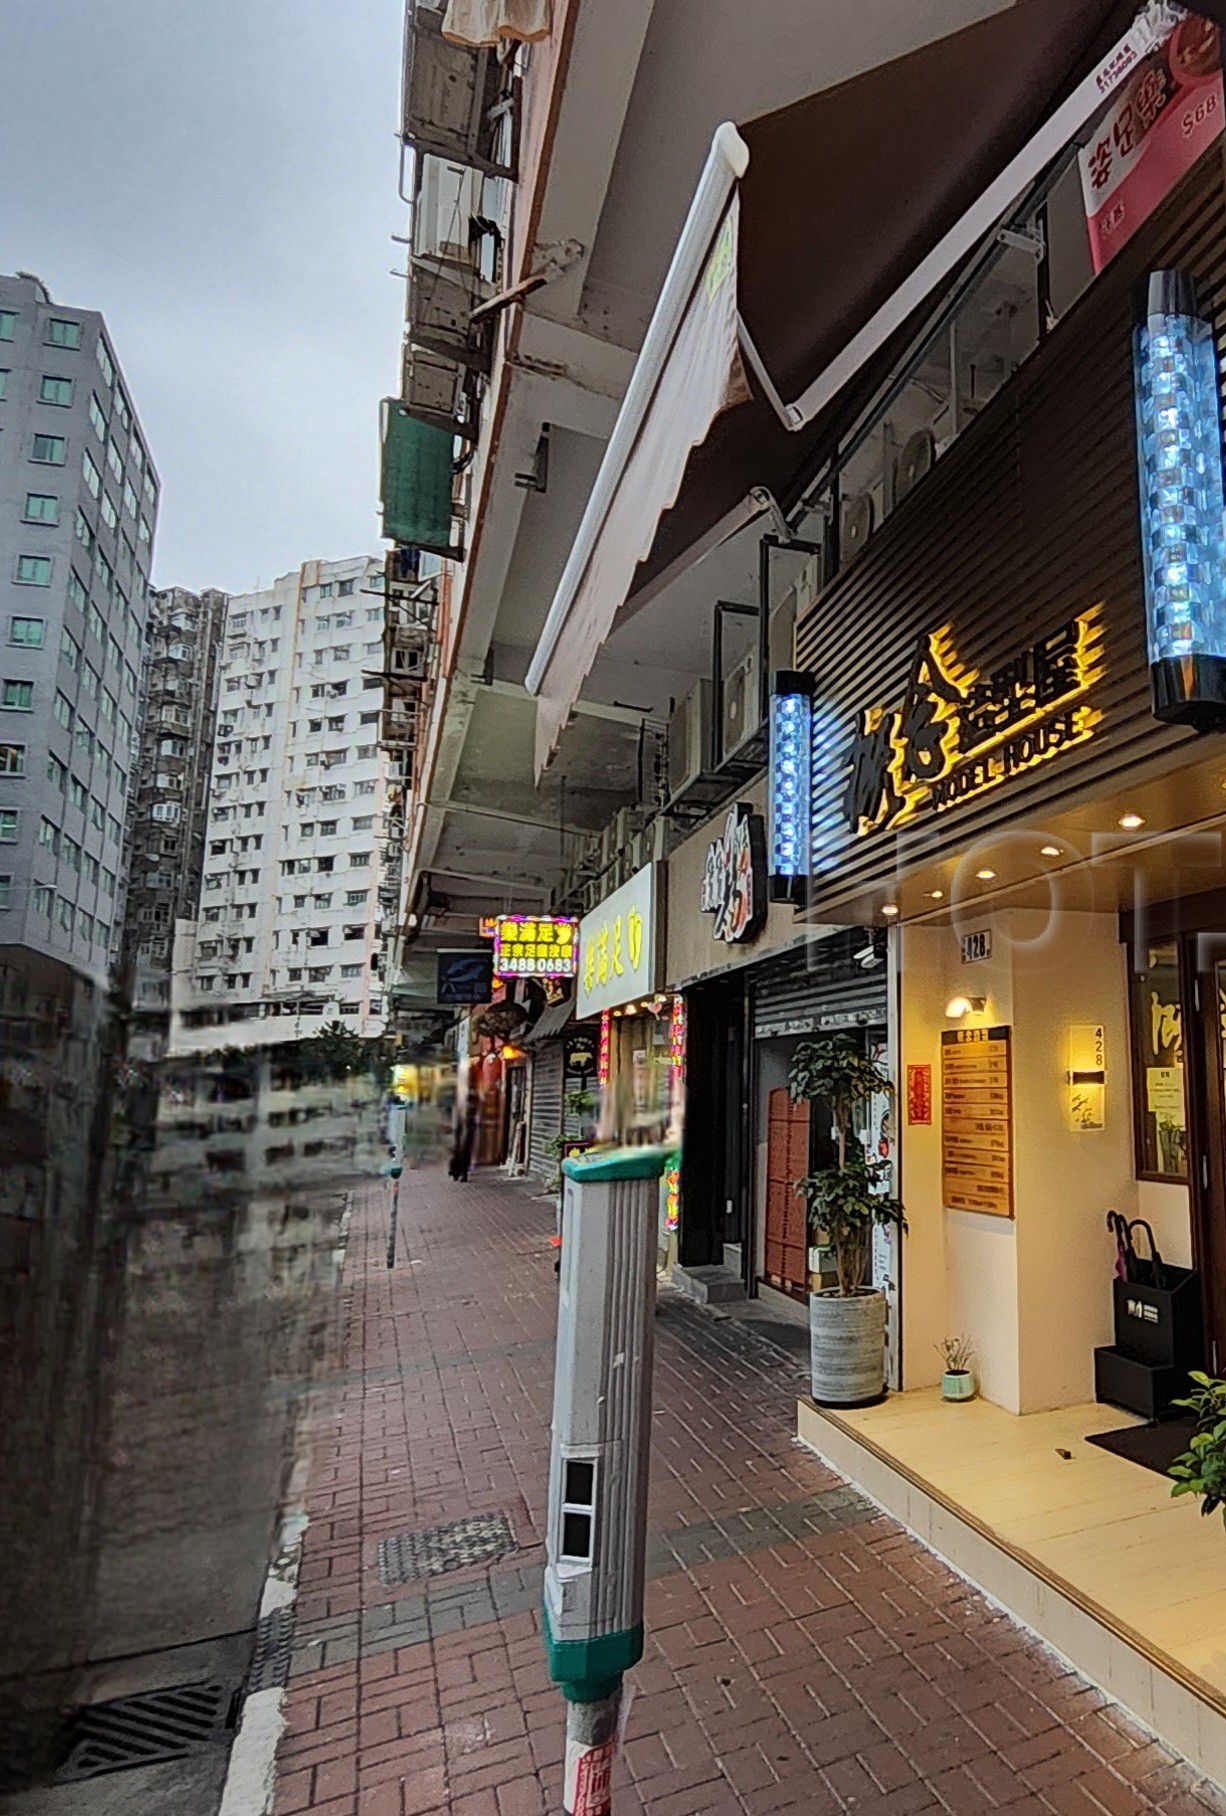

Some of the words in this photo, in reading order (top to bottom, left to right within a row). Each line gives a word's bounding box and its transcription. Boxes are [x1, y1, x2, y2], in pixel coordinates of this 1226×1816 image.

[1181, 94, 1218, 137] $68
[932, 757, 1006, 812] MODEL
[1003, 705, 1095, 777] HOUSE
[966, 932, 986, 960] 428
[1094, 1028, 1103, 1066] 428
